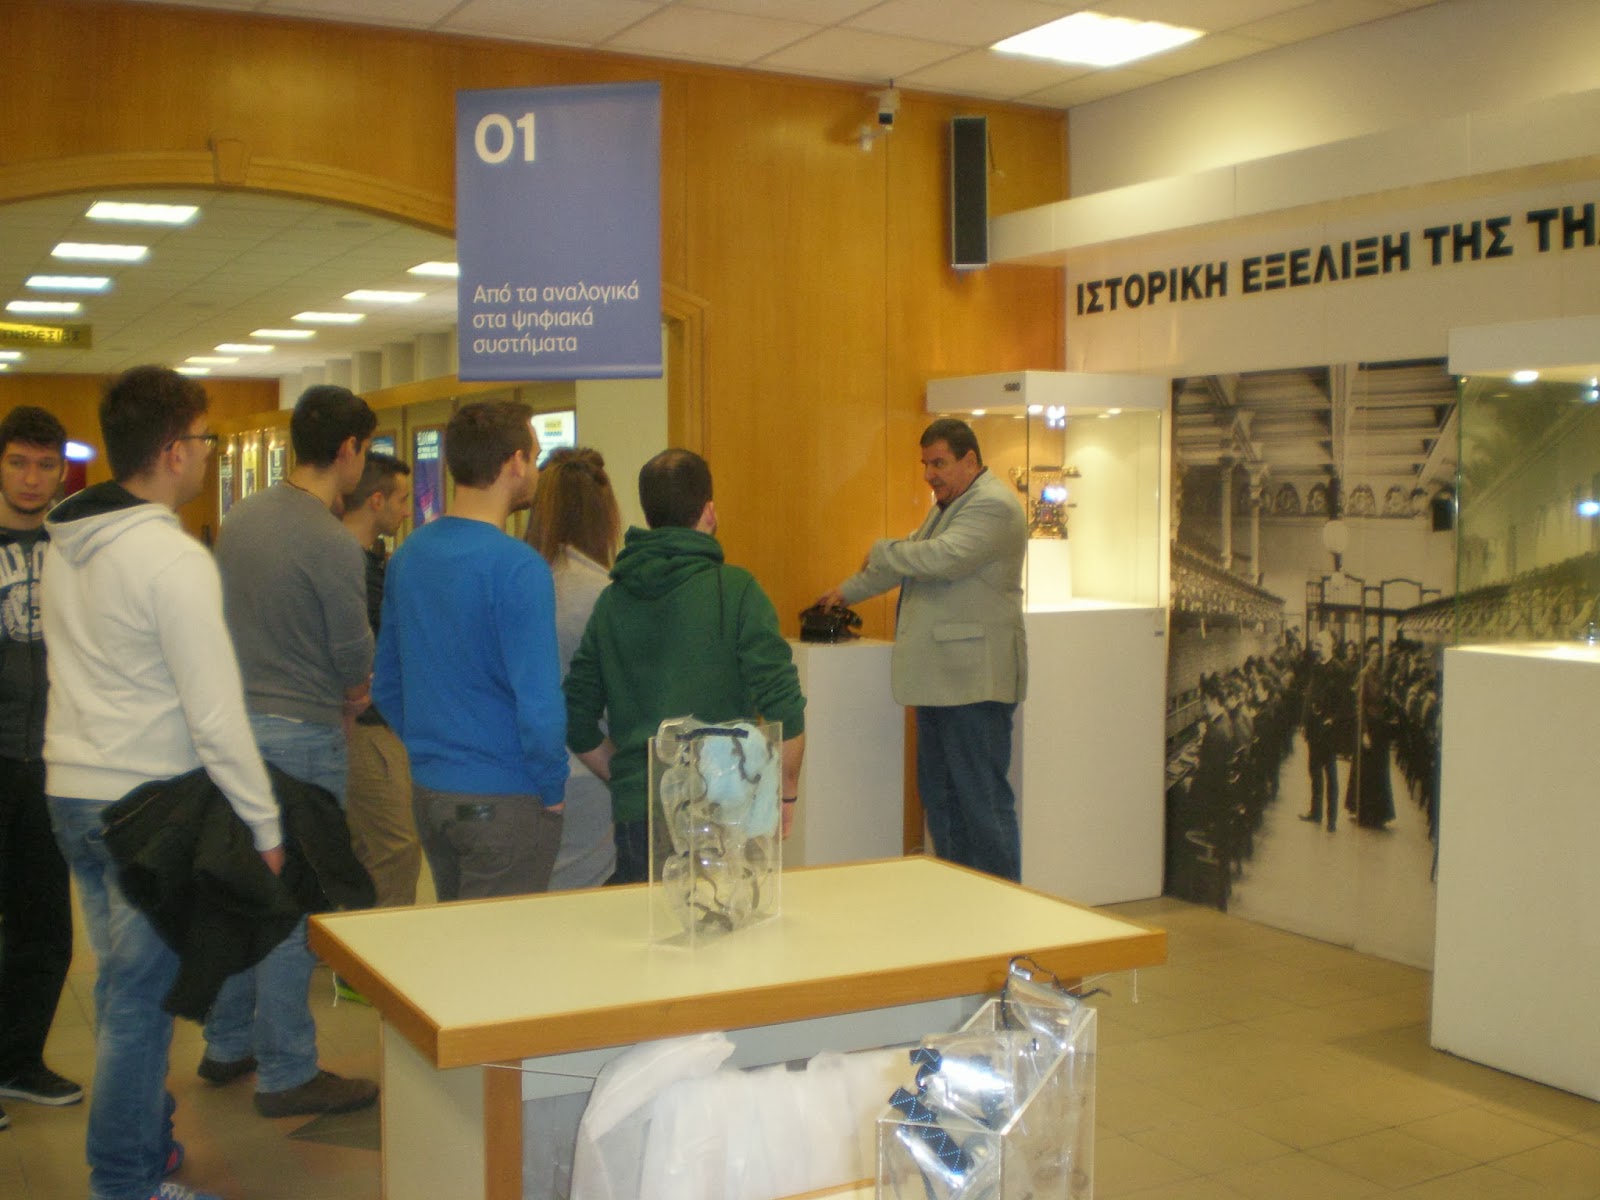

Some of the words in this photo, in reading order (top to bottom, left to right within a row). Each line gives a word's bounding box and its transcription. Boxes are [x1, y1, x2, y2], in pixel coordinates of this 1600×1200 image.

[474, 112, 536, 164] 01
[1077, 261, 1229, 316] ΙΣΤΟΡΙΚΗ
[1242, 231, 1411, 294] ΕΞΕΛΙΞΗ
[1423, 215, 1515, 267] ΤΗΣ
[1526, 202, 1600, 252] ΤΗ
[473, 283, 512, 304] Από
[516, 287, 538, 303] τα
[543, 280, 640, 304] αναλογικά
[473, 312, 507, 328] στα
[512, 306, 594, 331] ψηφιακά
[473, 333, 578, 356] συστήματα
